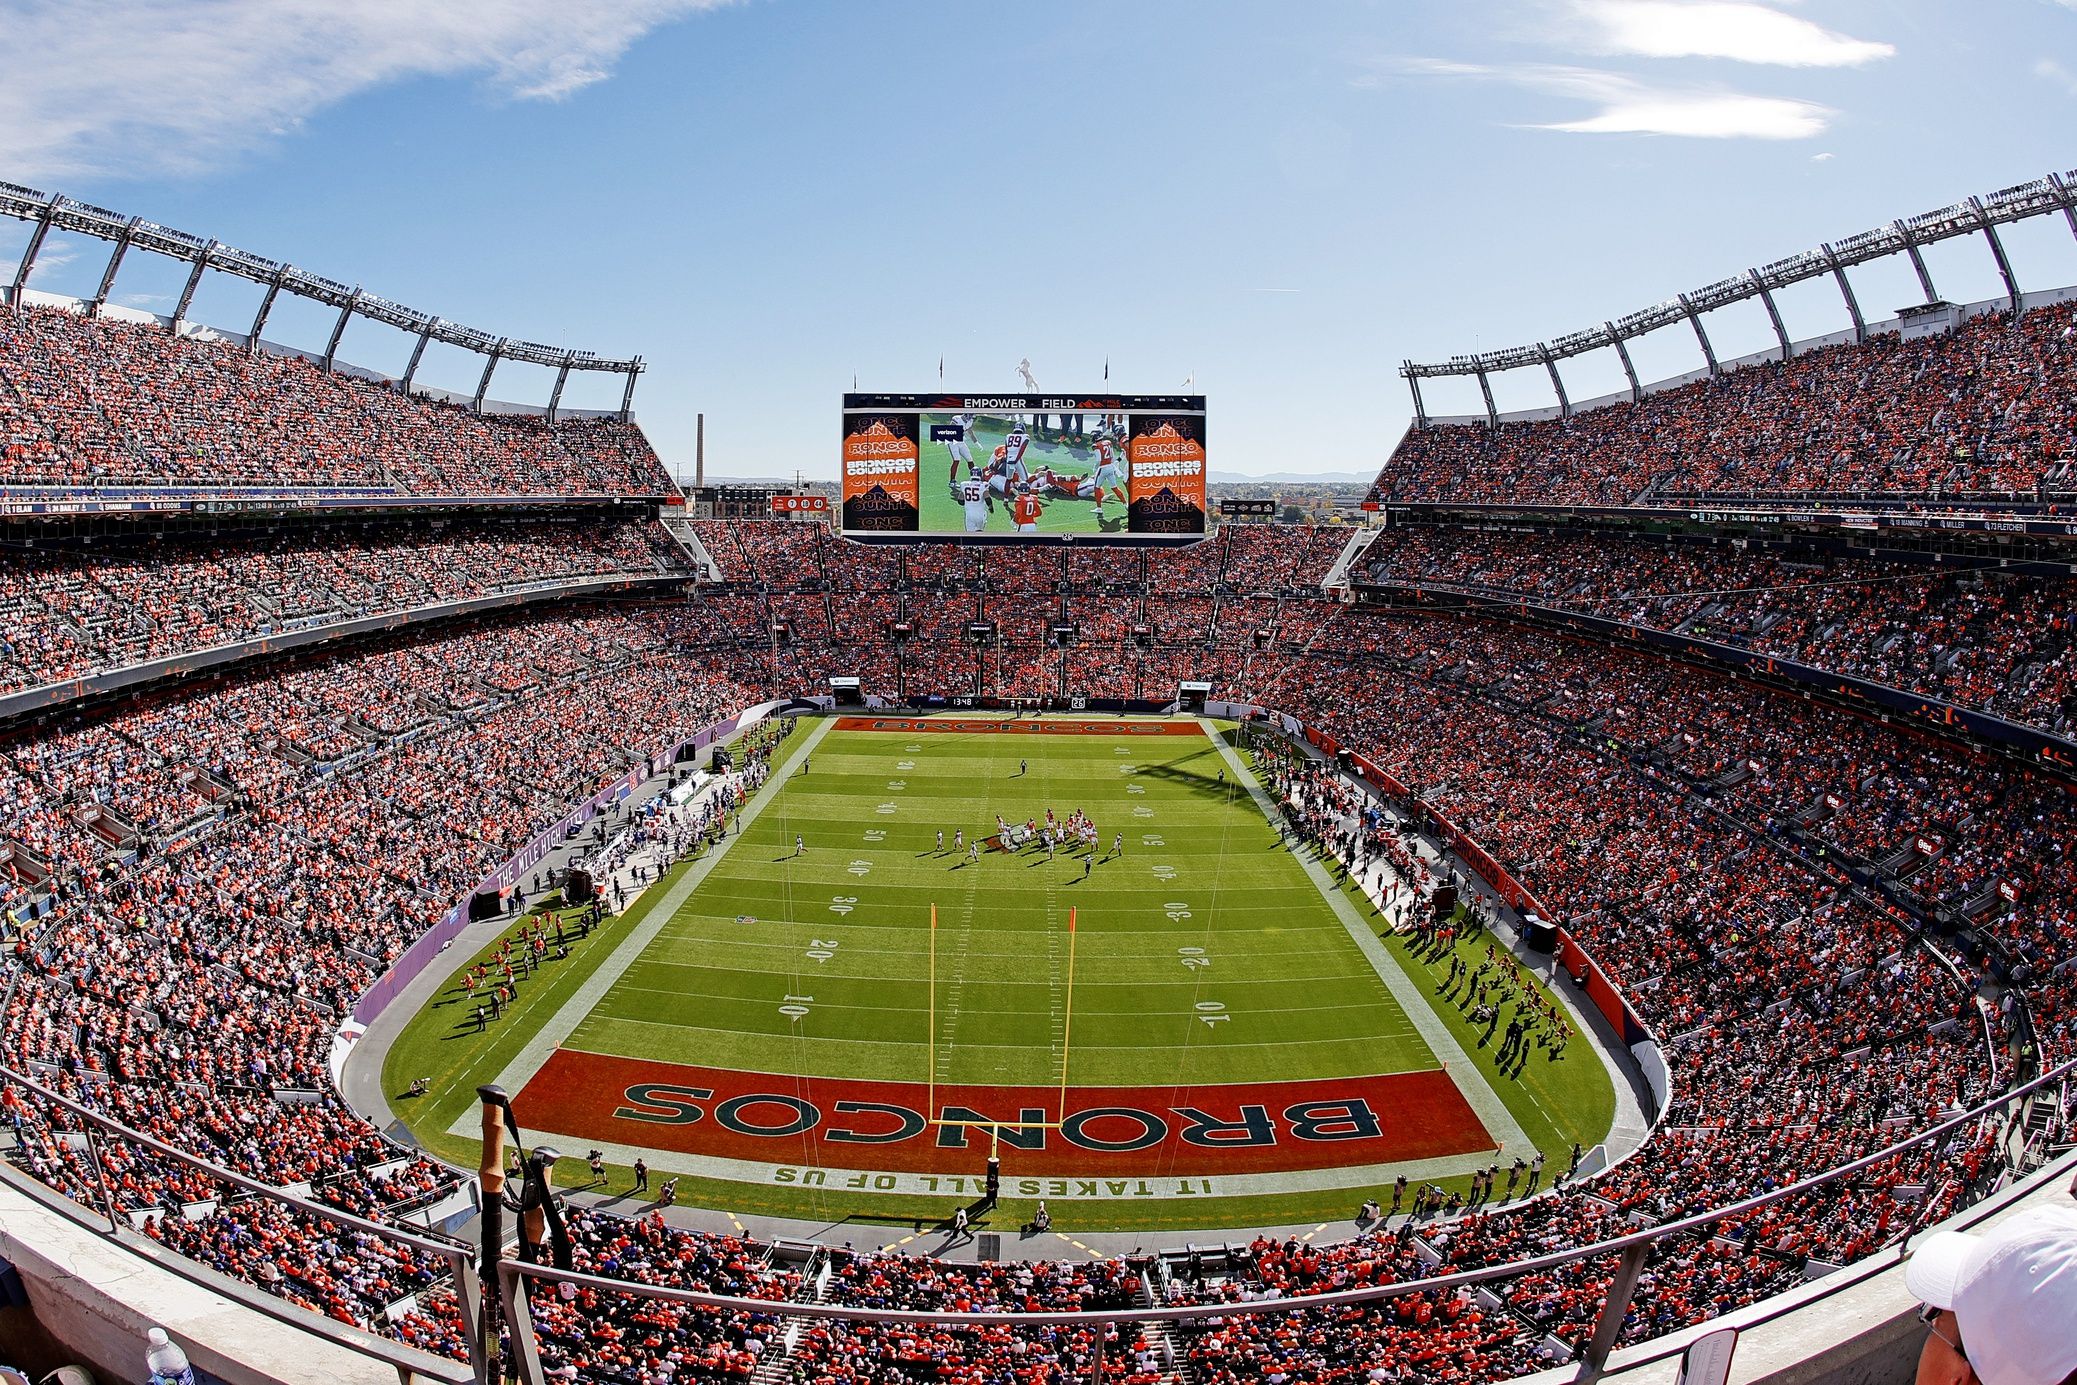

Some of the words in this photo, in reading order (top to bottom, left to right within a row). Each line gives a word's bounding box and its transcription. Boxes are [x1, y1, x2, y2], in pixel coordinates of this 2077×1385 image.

[964, 398, 1026, 408] EMPOWER
[1042, 399, 1076, 408] FIELD
[1008, 435, 1022, 447] 89
[846, 458, 916, 468] BRONCOS
[1132, 460, 1202, 471] BRONCOS
[847, 465, 916, 475] COUNTRY
[1132, 467, 1202, 478] COUNTRY
[964, 487, 980, 502] 65
[16, 505, 33, 513] ELAM
[60, 504, 80, 512] BAILEY
[218, 502, 223, 511] 7
[237, 502, 242, 511] 0
[814, 499, 823, 508] 44
[1026, 501, 1034, 516] 0
[1901, 519, 1923, 527] MANNING
[1946, 521, 1965, 529] MILLER
[1990, 522, 1997, 530] 73
[1997, 523, 2024, 531] FLETCHER
[953, 698, 972, 706] 13:48
[1073, 699, 1083, 708] 26
[872, 720, 1165, 733] BRONCOS
[496, 863, 515, 891] THE
[518, 843, 540, 875] MILE
[541, 826, 561, 855] HIGH
[1455, 838, 1499, 885] BRONCOS
[828, 895, 859, 917] 30
[1163, 902, 1193, 923] 30
[806, 938, 839, 963] 20
[1177, 946, 1212, 971] 20
[778, 993, 814, 1022] 10
[1194, 1001, 1232, 1029] 10
[612, 1083, 1383, 1152] BRONCOS
[774, 1167, 827, 1186] US
[846, 1174, 897, 1189] OF
[1019, 1180, 1154, 1195] TAKES
[1176, 1179, 1212, 1194] IT
[1421, 1308, 1431, 1316] 24
